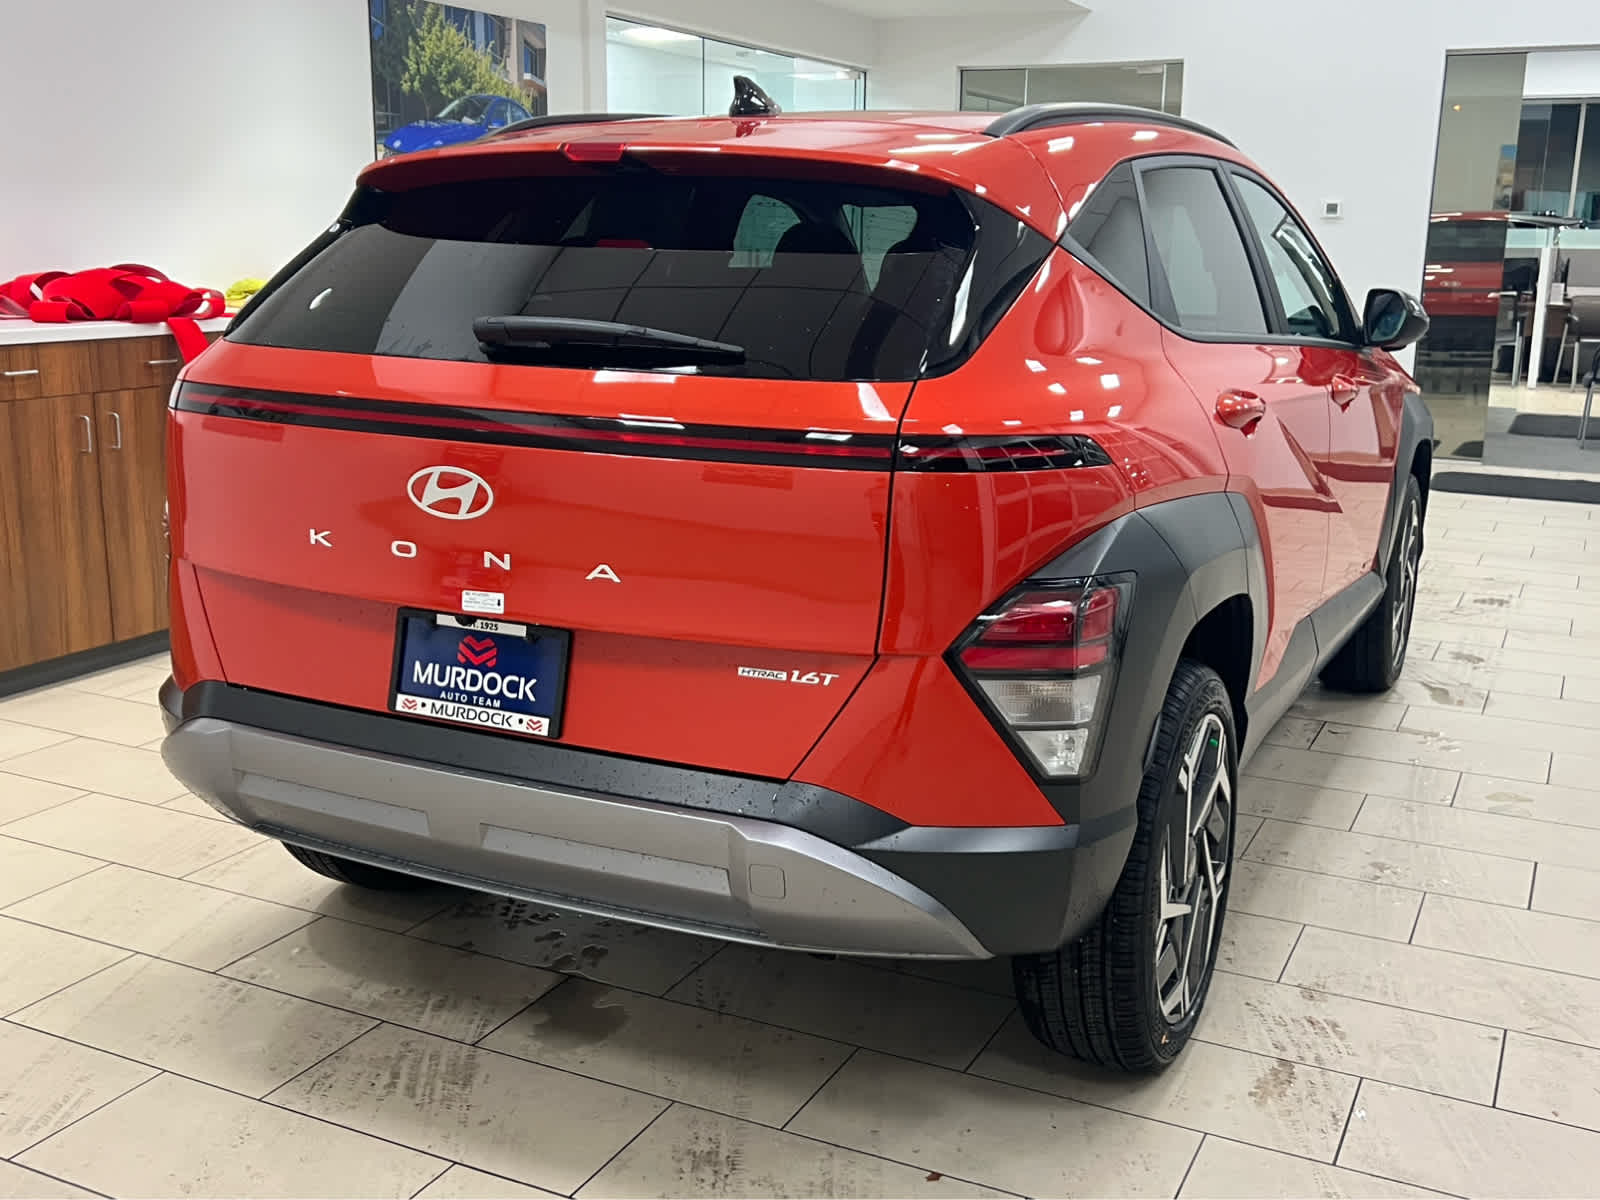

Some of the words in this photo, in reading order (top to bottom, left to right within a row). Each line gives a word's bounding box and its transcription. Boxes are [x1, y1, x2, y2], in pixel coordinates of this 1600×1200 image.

[308, 528, 622, 584] KONA
[480, 621, 499, 632] 1925
[412, 660, 537, 702] MURDOCK
[740, 668, 784, 680] HTRAC
[440, 690, 468, 703] AUTO
[472, 696, 501, 708] TEAM
[430, 702, 513, 728] MURDOCK
